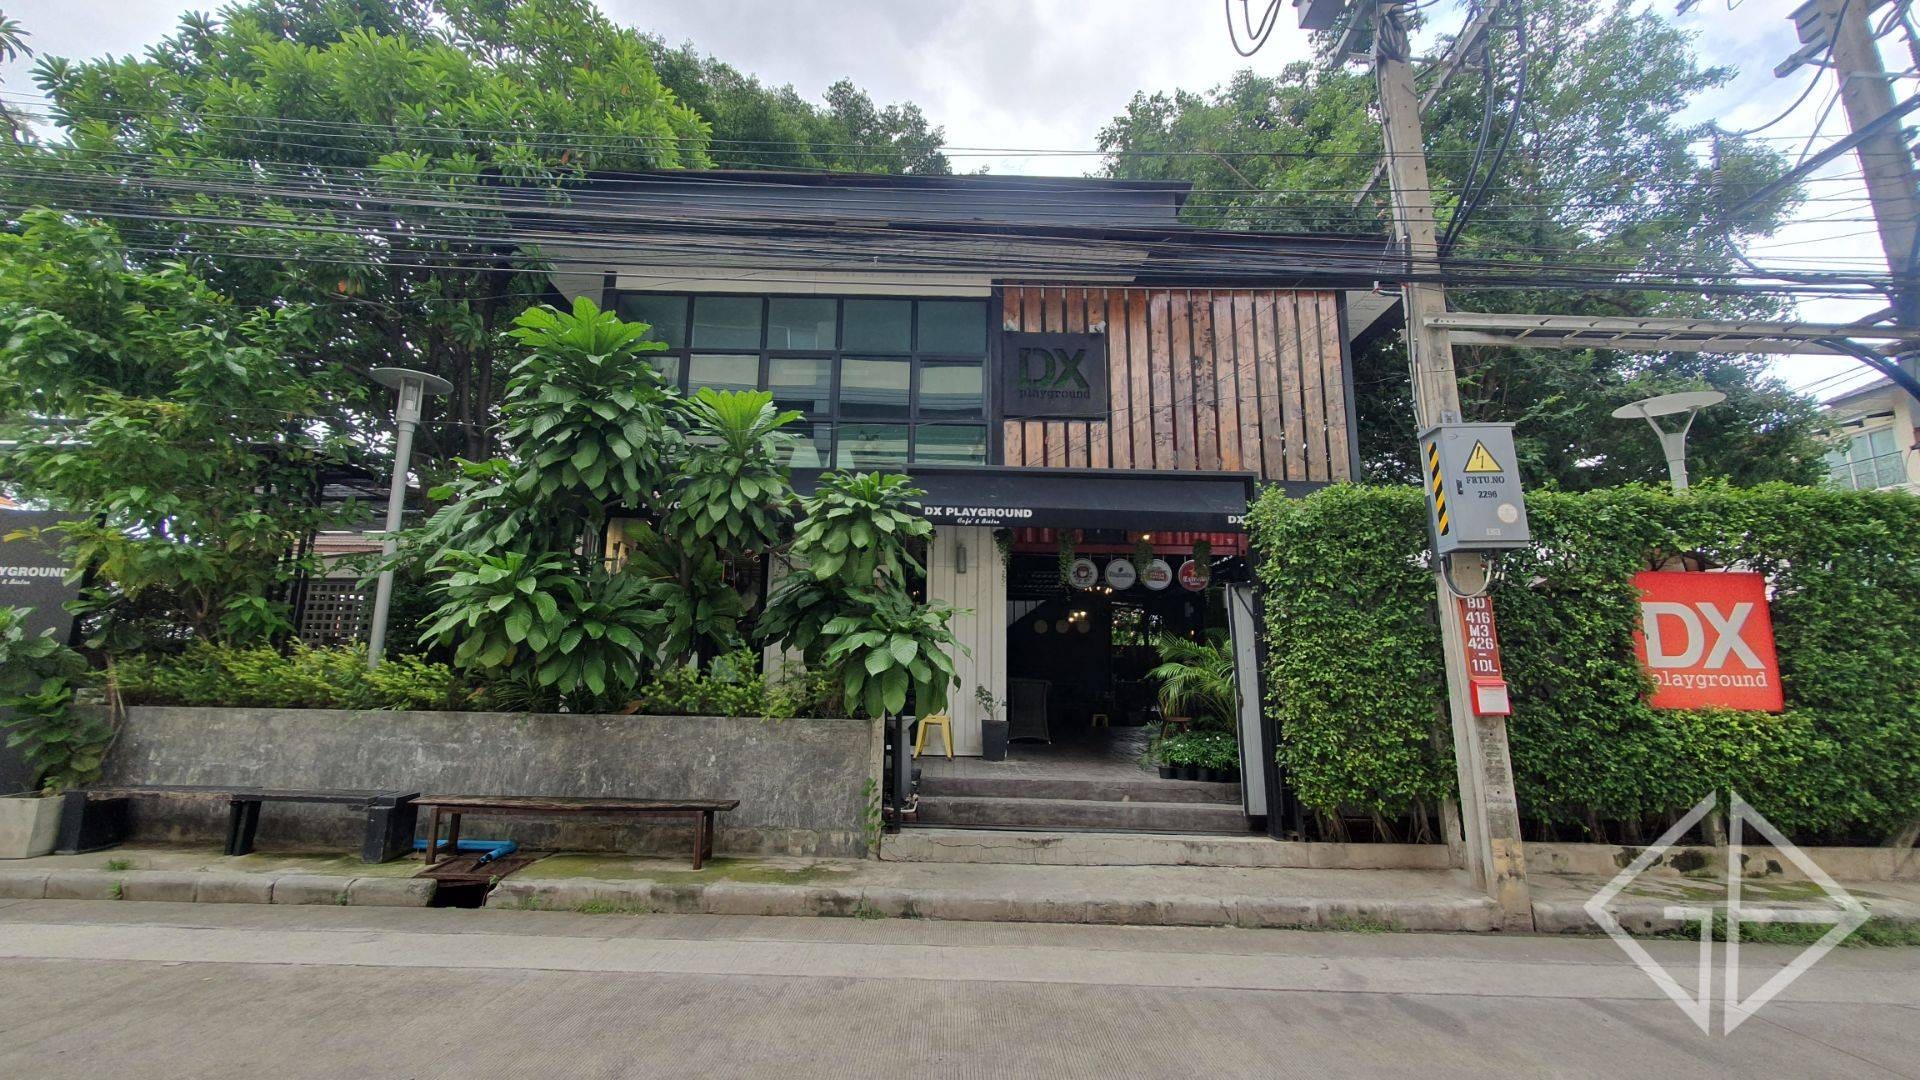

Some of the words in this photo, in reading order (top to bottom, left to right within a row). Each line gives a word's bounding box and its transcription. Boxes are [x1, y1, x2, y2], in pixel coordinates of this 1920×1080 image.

[1019, 347, 1090, 388] DX
[1019, 388, 1091, 400] playground
[924, 506, 943, 516] DX
[945, 507, 1033, 518] PLAYGROUND
[1227, 515, 1245, 524] DX
[1467, 598, 1486, 609] BD
[1465, 611, 1491, 624] 416
[1469, 624, 1489, 638] M3
[1641, 602, 1766, 669] DX
[1468, 637, 1494, 650] 426
[1472, 659, 1498, 672] 1DL
